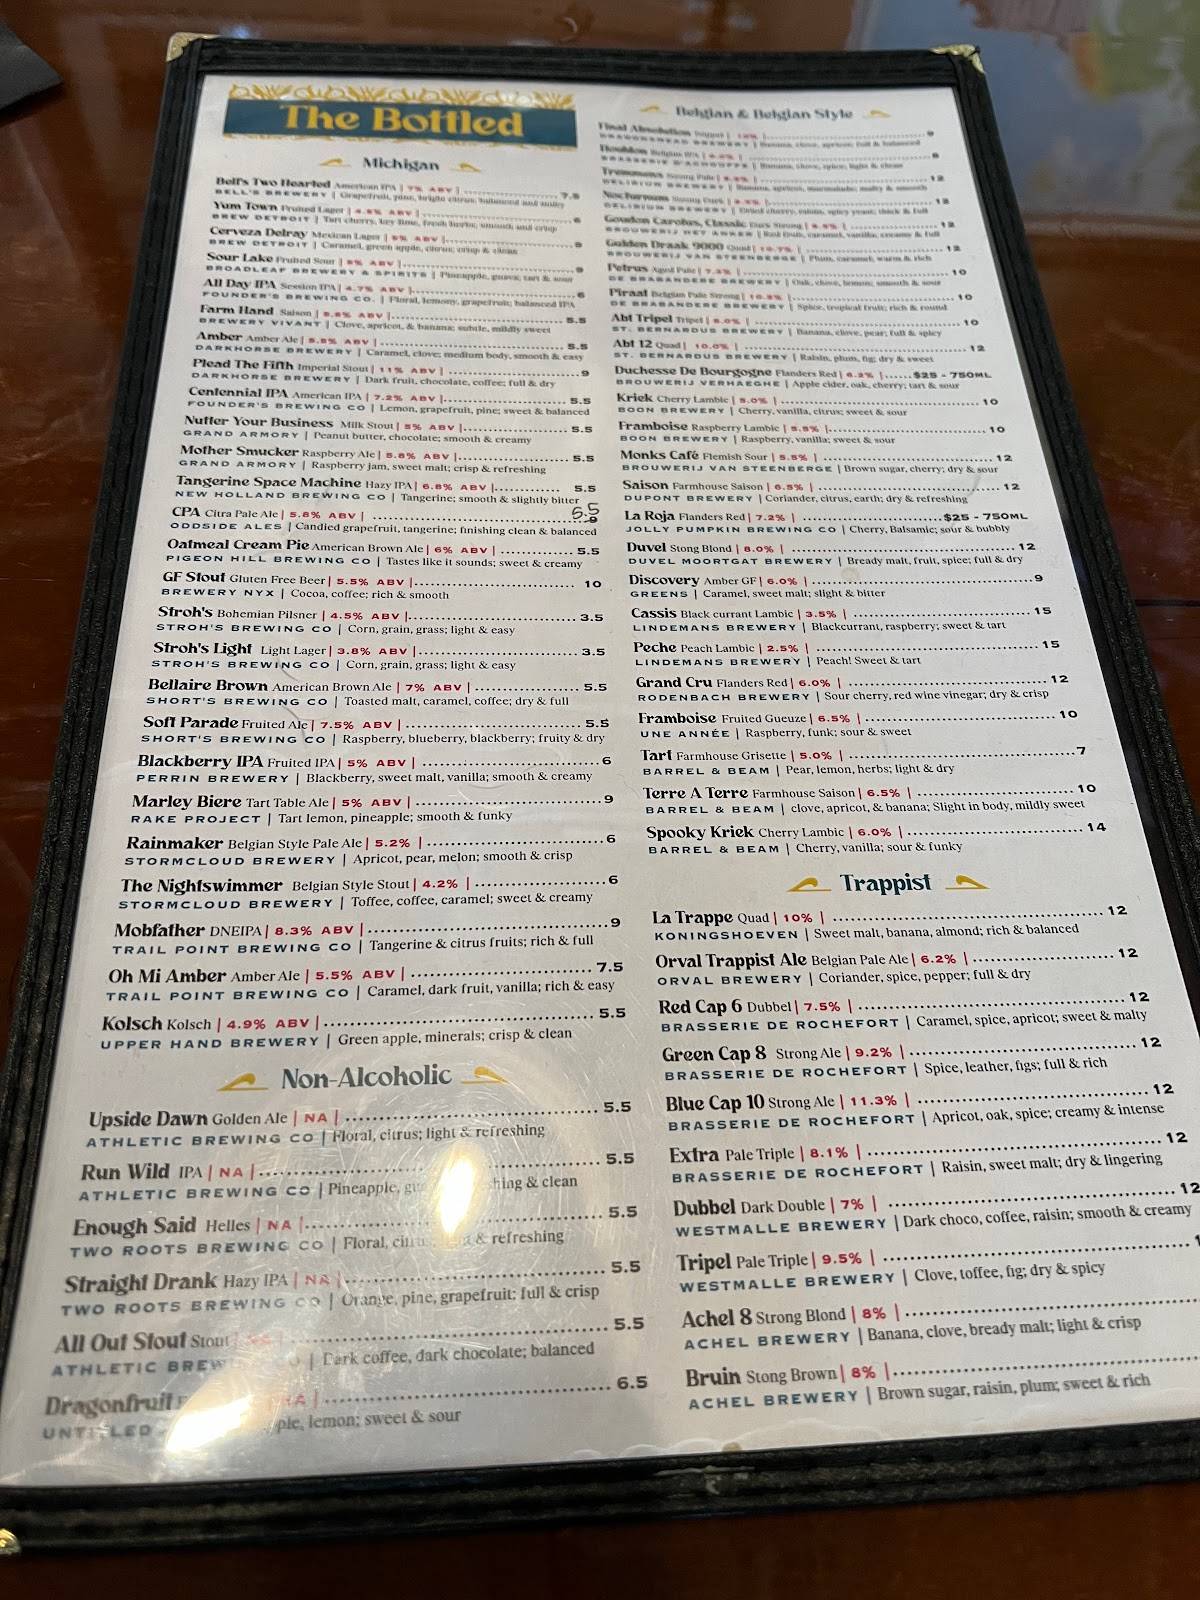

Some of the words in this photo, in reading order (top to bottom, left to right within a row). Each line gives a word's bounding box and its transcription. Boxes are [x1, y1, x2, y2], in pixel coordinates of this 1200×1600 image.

[279, 103, 360, 132] The
[372, 107, 524, 138] Bottled
[363, 157, 440, 172] Michigan
[213, 201, 242, 210] Yum
[245, 201, 278, 211] Town
[209, 226, 262, 237] Cerveza
[265, 227, 308, 240] Delray
[207, 252, 240, 262] Sour
[243, 253, 274, 263] Lake
[203, 278, 223, 287] All
[226, 278, 251, 291] Day
[254, 280, 277, 289] IPA
[200, 304, 235, 314] Farm
[238, 305, 274, 316] Hand
[611, 313, 633, 323] Abt
[636, 313, 673, 325] Tripel
[193, 358, 231, 369] Plead
[234, 359, 260, 370] The
[263, 360, 294, 370] Fifth
[614, 365, 677, 376] Duchesse
[679, 366, 697, 376] De
[699, 366, 772, 378] Bourgogne
[188, 386, 262, 398] Centennial
[266, 388, 289, 398] IPA
[184, 415, 230, 426] Nutter
[233, 416, 268, 427] Your
[271, 417, 334, 428] Business
[620, 449, 667, 460] Monks
[669, 450, 699, 460] Café
[702, 452, 742, 461] Flemish
[744, 452, 768, 461] Sour
[176, 475, 250, 488] Tangerine
[253, 476, 297, 489] Space
[300, 477, 362, 488] Machine
[365, 480, 392, 491] Hazy
[394, 481, 413, 490] IPA
[422, 483, 453, 491] 6.8%
[574, 485, 596, 493] 5.5
[624, 510, 641, 521] La
[644, 510, 676, 523] Roja
[679, 512, 723, 521] Flanders
[725, 513, 746, 521] Red
[755, 514, 786, 522] 7.2%
[943, 513, 970, 522] $25
[982, 512, 1028, 521] 750ML
[295, 522, 340, 532] Candied
[342, 524, 401, 534] grapefruit,
[403, 525, 457, 535] tangerine;
[460, 526, 506, 536] finishing
[508, 527, 536, 535] clean
[538, 527, 548, 536] &
[550, 527, 597, 536] balanced
[162, 571, 183, 582] GF
[185, 571, 226, 583] Stout
[229, 574, 267, 584] Gluten
[271, 575, 296, 584] Free
[299, 576, 326, 585] Beer
[629, 574, 700, 588] Discovery
[631, 607, 677, 619] Cassis
[680, 610, 711, 619] Black
[712, 611, 752, 619] currant
[755, 609, 794, 618] Lambic
[1034, 606, 1052, 615] 15
[153, 641, 210, 654] Stroh's
[213, 642, 252, 657] Light
[261, 645, 291, 657] Light
[294, 646, 327, 657] Lager
[337, 647, 371, 656] 3.8%
[582, 648, 605, 656] 3.5
[640, 730, 671, 738] UNE
[678, 728, 730, 738] ANNÉE
[137, 754, 232, 770] Blackberry
[236, 755, 264, 768] IPA
[646, 825, 706, 841] Spooky
[709, 824, 755, 838] Kriek
[758, 827, 799, 840] Cherry
[801, 827, 845, 838] Lambic
[126, 836, 224, 850] Rainmaker
[227, 839, 274, 852] Belgian
[277, 839, 310, 851] Style
[312, 838, 339, 849] Pale
[341, 838, 363, 848] Ale
[840, 873, 931, 894] Trappist
[652, 911, 672, 924] La
[674, 910, 734, 927] Trappe
[737, 912, 770, 925] Quad
[783, 913, 813, 923] 10%
[1108, 905, 1128, 916] 12
[114, 923, 206, 937] Mobfather
[209, 925, 262, 937] DNEIPA
[274, 925, 313, 936] 8.3%
[321, 925, 354, 935] ABV
[610, 917, 621, 928] 9
[655, 930, 798, 941] KONINGSHOEVEN
[814, 928, 851, 939] Sweet
[853, 927, 884, 939] malt,
[885, 927, 933, 938] banana,
[935, 925, 984, 937] almond;
[986, 925, 1011, 936] rich
[1013, 924, 1025, 935] &
[1025, 923, 1080, 935] balanced
[102, 1015, 163, 1031] Kolsch
[167, 1018, 211, 1031] Kolsch
[226, 1018, 266, 1030] 4.9%
[275, 1018, 310, 1029] ABV
[599, 1007, 626, 1019] 5.5
[662, 1047, 715, 1062] Green
[718, 1045, 751, 1064] Cap
[755, 1045, 767, 1060] 8
[282, 1064, 452, 1089] Non-Alcoholic
[665, 1069, 765, 1081] BRASSERIE
[772, 1068, 795, 1078] DE
[802, 1065, 907, 1077] ROCHEFORT
[89, 1110, 152, 1130] Upside
[156, 1110, 208, 1127] Dawn
[669, 1147, 720, 1163] Extra
[725, 1148, 754, 1162] Pale
[755, 1147, 795, 1163] Triple
[810, 1146, 849, 1159] 8.1%
[1166, 1131, 1188, 1144] 12
[673, 1198, 736, 1217] Dubbel
[64, 1273, 149, 1294] Straight
[153, 1271, 218, 1291] Drank
[682, 1308, 735, 1328] Achel
[739, 1307, 753, 1326] 8
[755, 1311, 803, 1325] Strong
[805, 1307, 847, 1322] Blond
[685, 1366, 742, 1387] Bruin
[746, 1370, 788, 1384] Stong
[790, 1368, 838, 1382] Brown
[851, 1365, 876, 1379] 8%
[44, 1392, 174, 1417] Dragonfruit
[617, 1375, 648, 1390] 6.5
